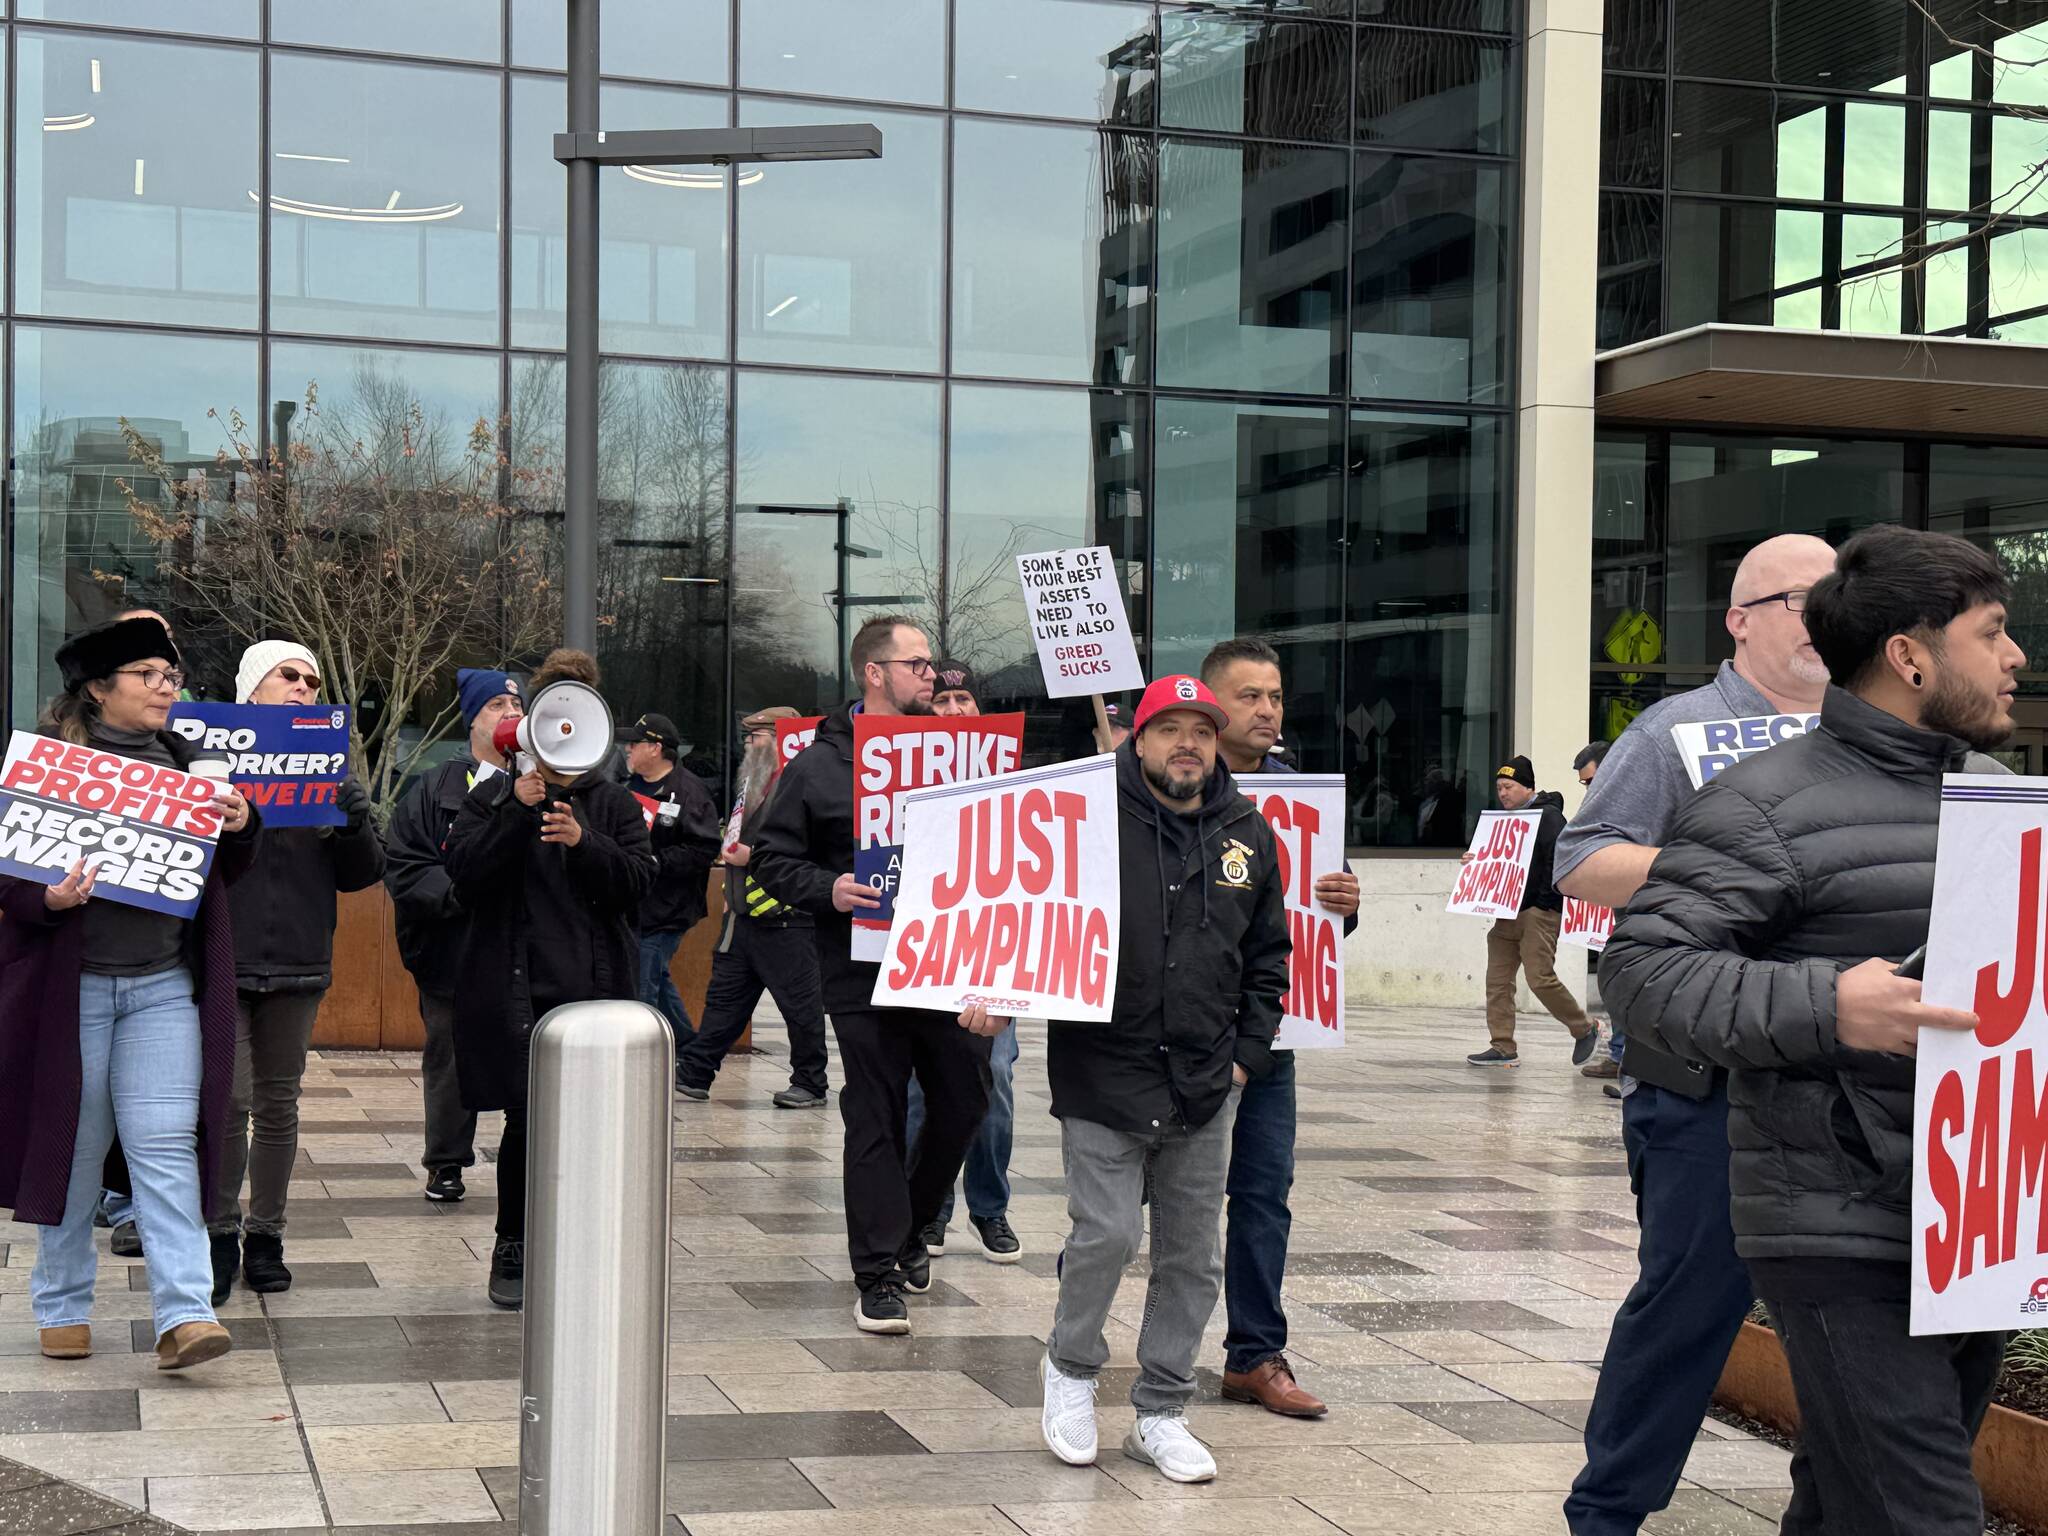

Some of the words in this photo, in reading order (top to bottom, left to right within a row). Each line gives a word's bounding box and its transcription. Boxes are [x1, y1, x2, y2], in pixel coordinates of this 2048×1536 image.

[1021, 556, 1065, 573] SOME
[1077, 551, 1100, 567] OF
[1023, 573, 1064, 588] YOUR
[1067, 566, 1103, 583] BEST
[1036, 606, 1073, 622] NEED
[1086, 602, 1108, 617] TO
[1039, 586, 1091, 605] ASSETS
[1036, 624, 1070, 640] LIVE
[1076, 619, 1115, 637] ALSO
[1054, 643, 1103, 660] GREED
[1060, 660, 1112, 677] SUCKS
[1703, 714, 1821, 752] REC
[27, 738, 216, 802] RECORD
[860, 731, 1018, 791] STRIKE
[3, 760, 222, 837] PROFITS
[1, 800, 205, 869] RECORD
[932, 788, 1087, 910] JUST
[1247, 794, 1320, 909] ST
[1477, 818, 1530, 864] JUST
[0, 824, 204, 901] WAGES
[1452, 861, 1525, 912] SAMPLING
[1564, 897, 1615, 937] SAMPL
[888, 901, 1109, 1008] SAMPLING
